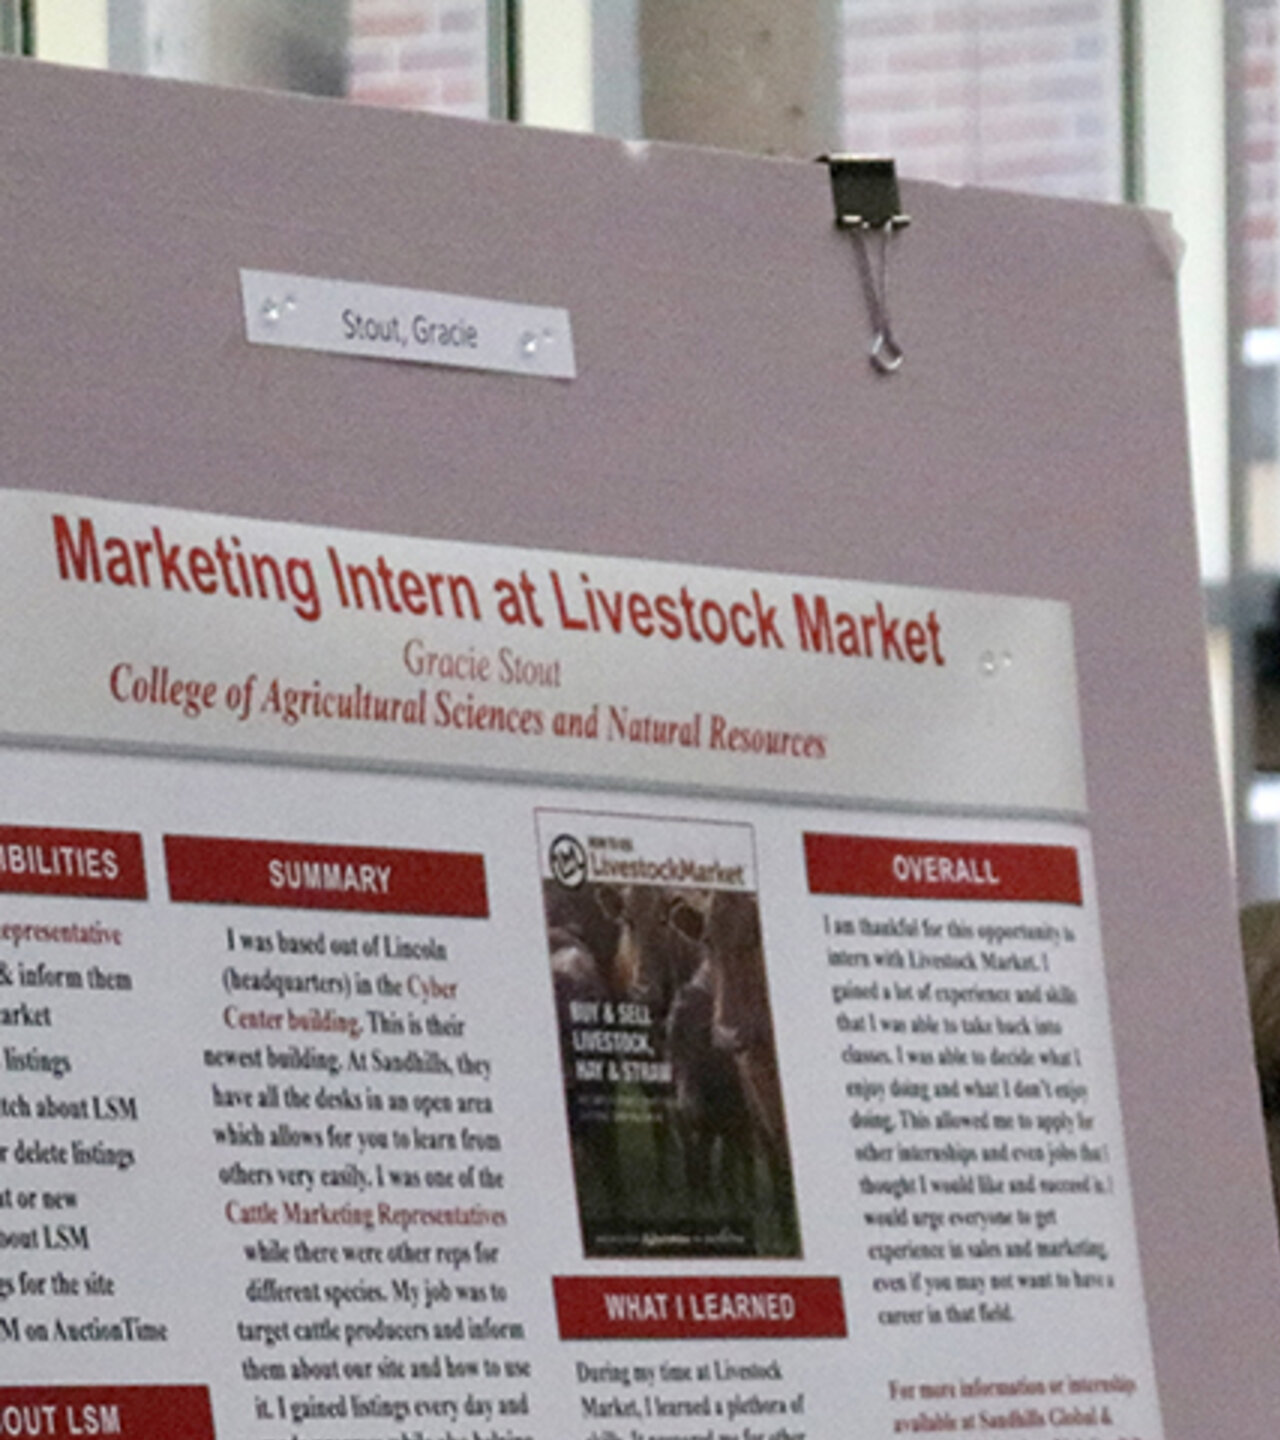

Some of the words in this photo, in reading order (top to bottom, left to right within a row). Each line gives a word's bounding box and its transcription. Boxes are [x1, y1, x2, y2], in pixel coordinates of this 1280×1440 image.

[341, 308, 408, 348] Stout,
[412, 314, 479, 349] Gracie
[51, 514, 322, 622] Marketing
[326, 546, 484, 621] Intern
[492, 569, 544, 628] at
[550, 569, 786, 650] Livestock
[792, 592, 946, 666] Market
[403, 638, 491, 684] Gracie
[498, 646, 562, 689] Stout
[109, 661, 218, 717] College
[225, 674, 258, 721] of
[261, 678, 428, 727] Agricultural
[433, 690, 545, 736] Sciences
[552, 704, 599, 741] and
[606, 706, 701, 750] Natural
[708, 714, 828, 759] Resources
[268, 859, 392, 894] SUMMARY
[892, 854, 1001, 886] OVERALL
[0, 921, 123, 949] epresentative
[227, 927, 235, 950] I
[239, 933, 274, 952] was
[278, 930, 325, 956] based
[330, 937, 359, 958] out
[362, 935, 381, 958] of
[383, 935, 448, 961] Lincoln
[19, 962, 83, 989] inform
[88, 965, 133, 991] them
[223, 966, 351, 1000] (headquarters)
[355, 972, 374, 996] in
[377, 973, 404, 997] the
[407, 974, 458, 1004] Cyber
[223, 1004, 284, 1031] Center
[287, 1008, 364, 1039] building.
[366, 1009, 405, 1035] This
[408, 1020, 423, 1036] is
[425, 1014, 466, 1037] their
[3, 1046, 72, 1080] listings
[36, 1095, 89, 1120] about
[93, 1096, 139, 1121] LSM
[14, 1139, 68, 1165] delete
[71, 1140, 136, 1171] listings
[18, 1192, 37, 1210] or
[42, 1192, 77, 1210] new
[225, 1200, 278, 1225] Cattle
[281, 1201, 375, 1231] Marketing
[377, 1202, 507, 1232] Representatives
[43, 1224, 90, 1250] LSM
[19, 1269, 47, 1296] for
[50, 1270, 79, 1297] the
[84, 1270, 115, 1297] site
[604, 1293, 668, 1320] WHAT
[676, 1294, 685, 1320] I
[690, 1293, 796, 1321] LEARNED
[25, 1322, 49, 1342] on
[53, 1315, 168, 1343] AuctionTime
[237, 1320, 290, 1346] target
[294, 1318, 341, 1341] cattle
[344, 1318, 430, 1346] producers
[433, 1318, 465, 1340] and
[468, 1317, 525, 1340] inform
[0, 1405, 56, 1436] OUT
[66, 1405, 121, 1435] LSM
